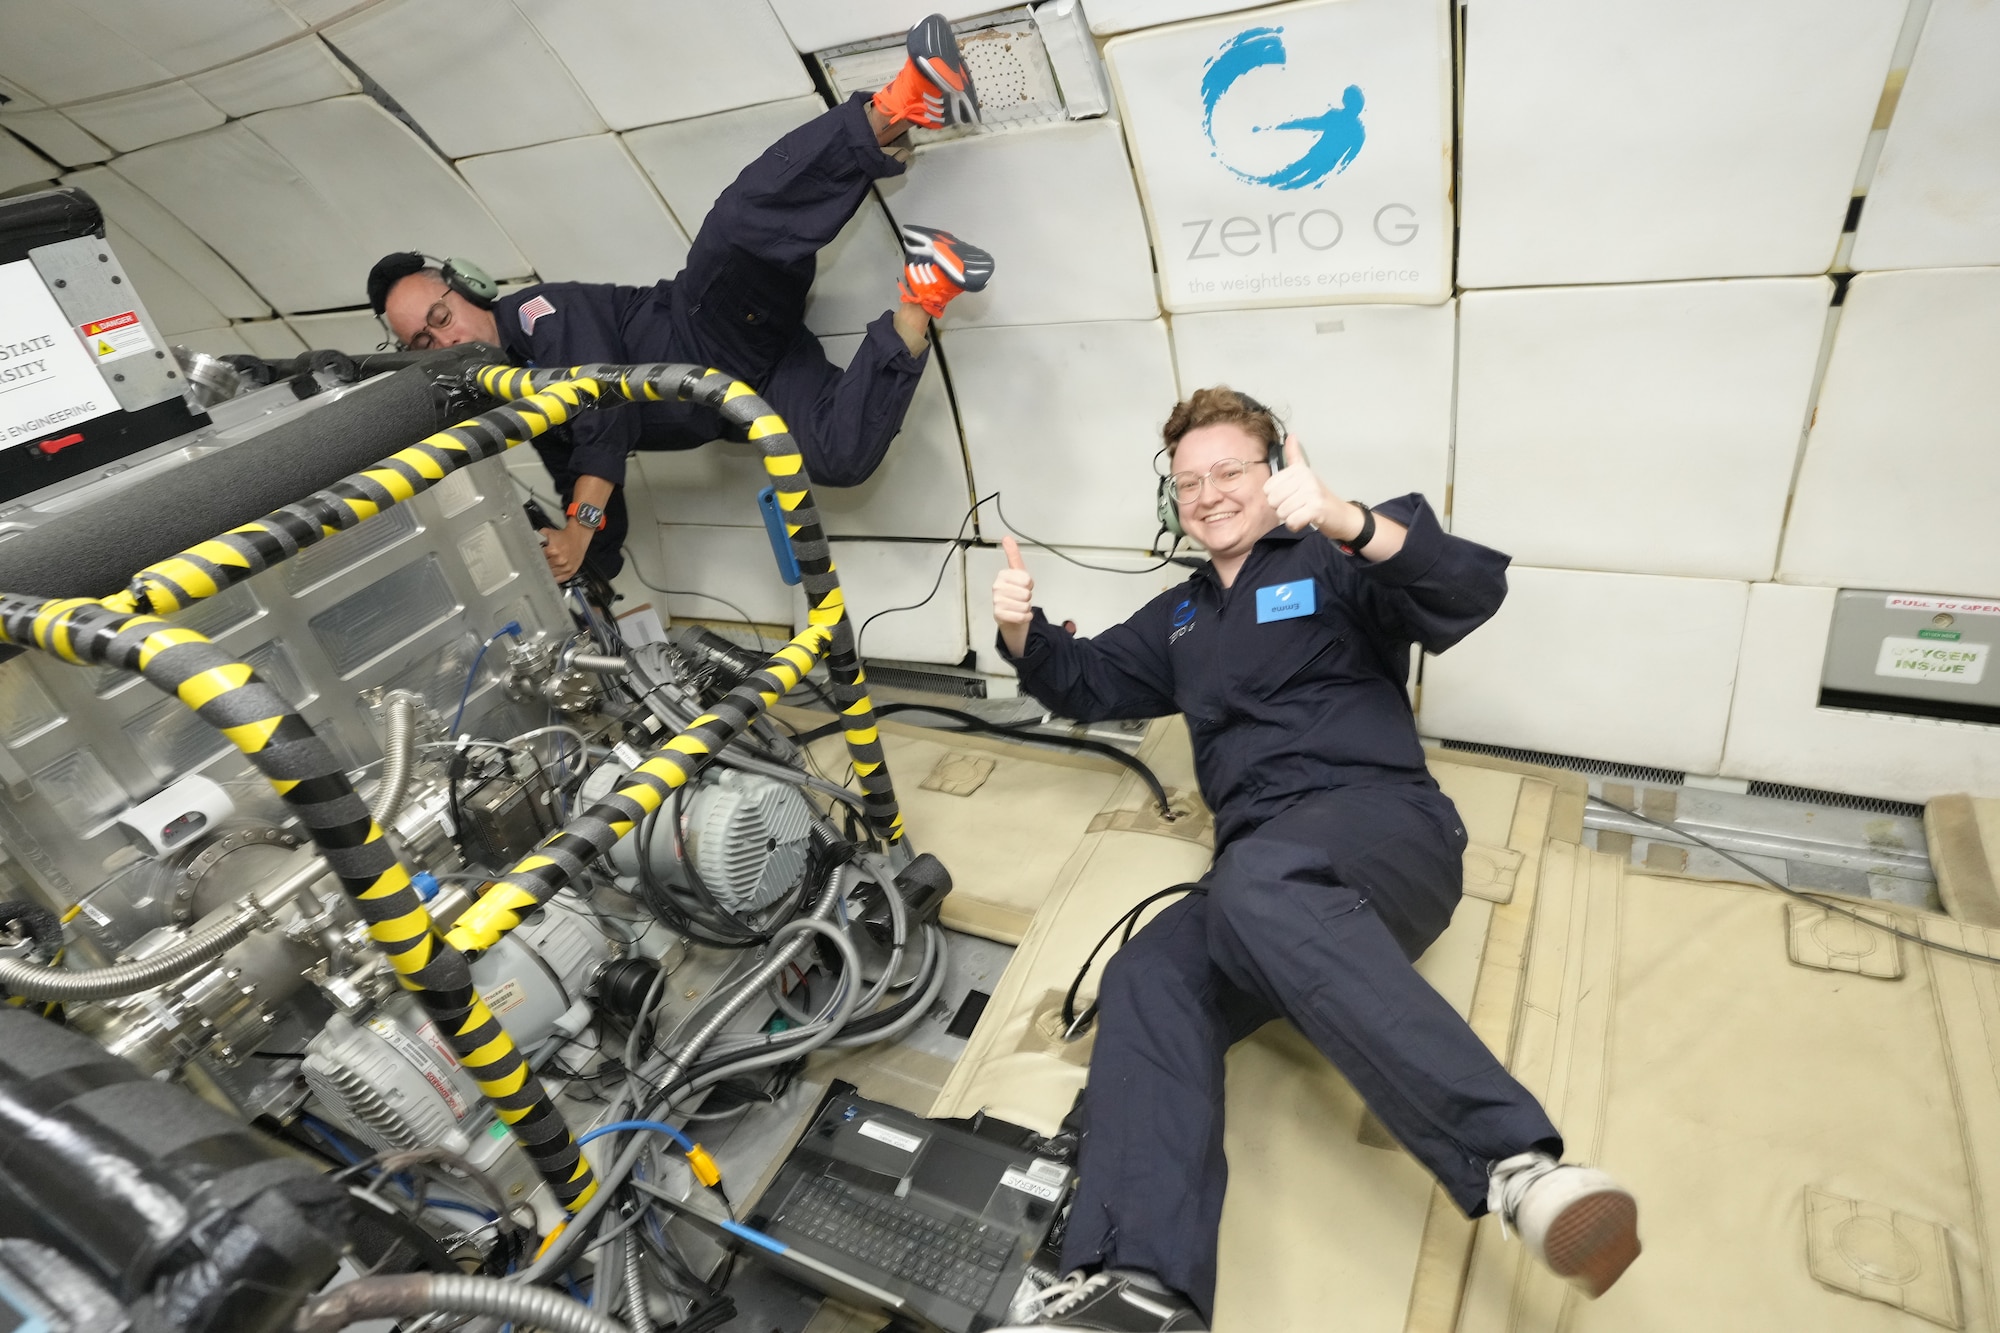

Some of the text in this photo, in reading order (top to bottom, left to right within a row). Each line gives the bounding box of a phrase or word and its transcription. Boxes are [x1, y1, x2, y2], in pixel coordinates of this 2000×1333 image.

[1181, 203, 1420, 261] zero G
[1188, 266, 1420, 294] the weightless experience
[99, 314, 134, 330] DANGER
[8, 400, 97, 438] ENGINEERING
[1271, 603, 1300, 613] Emma
[1891, 599, 1931, 609] PULL
[1936, 602, 1957, 610] TO
[1006, 1175, 1052, 1198] CAMERAS
